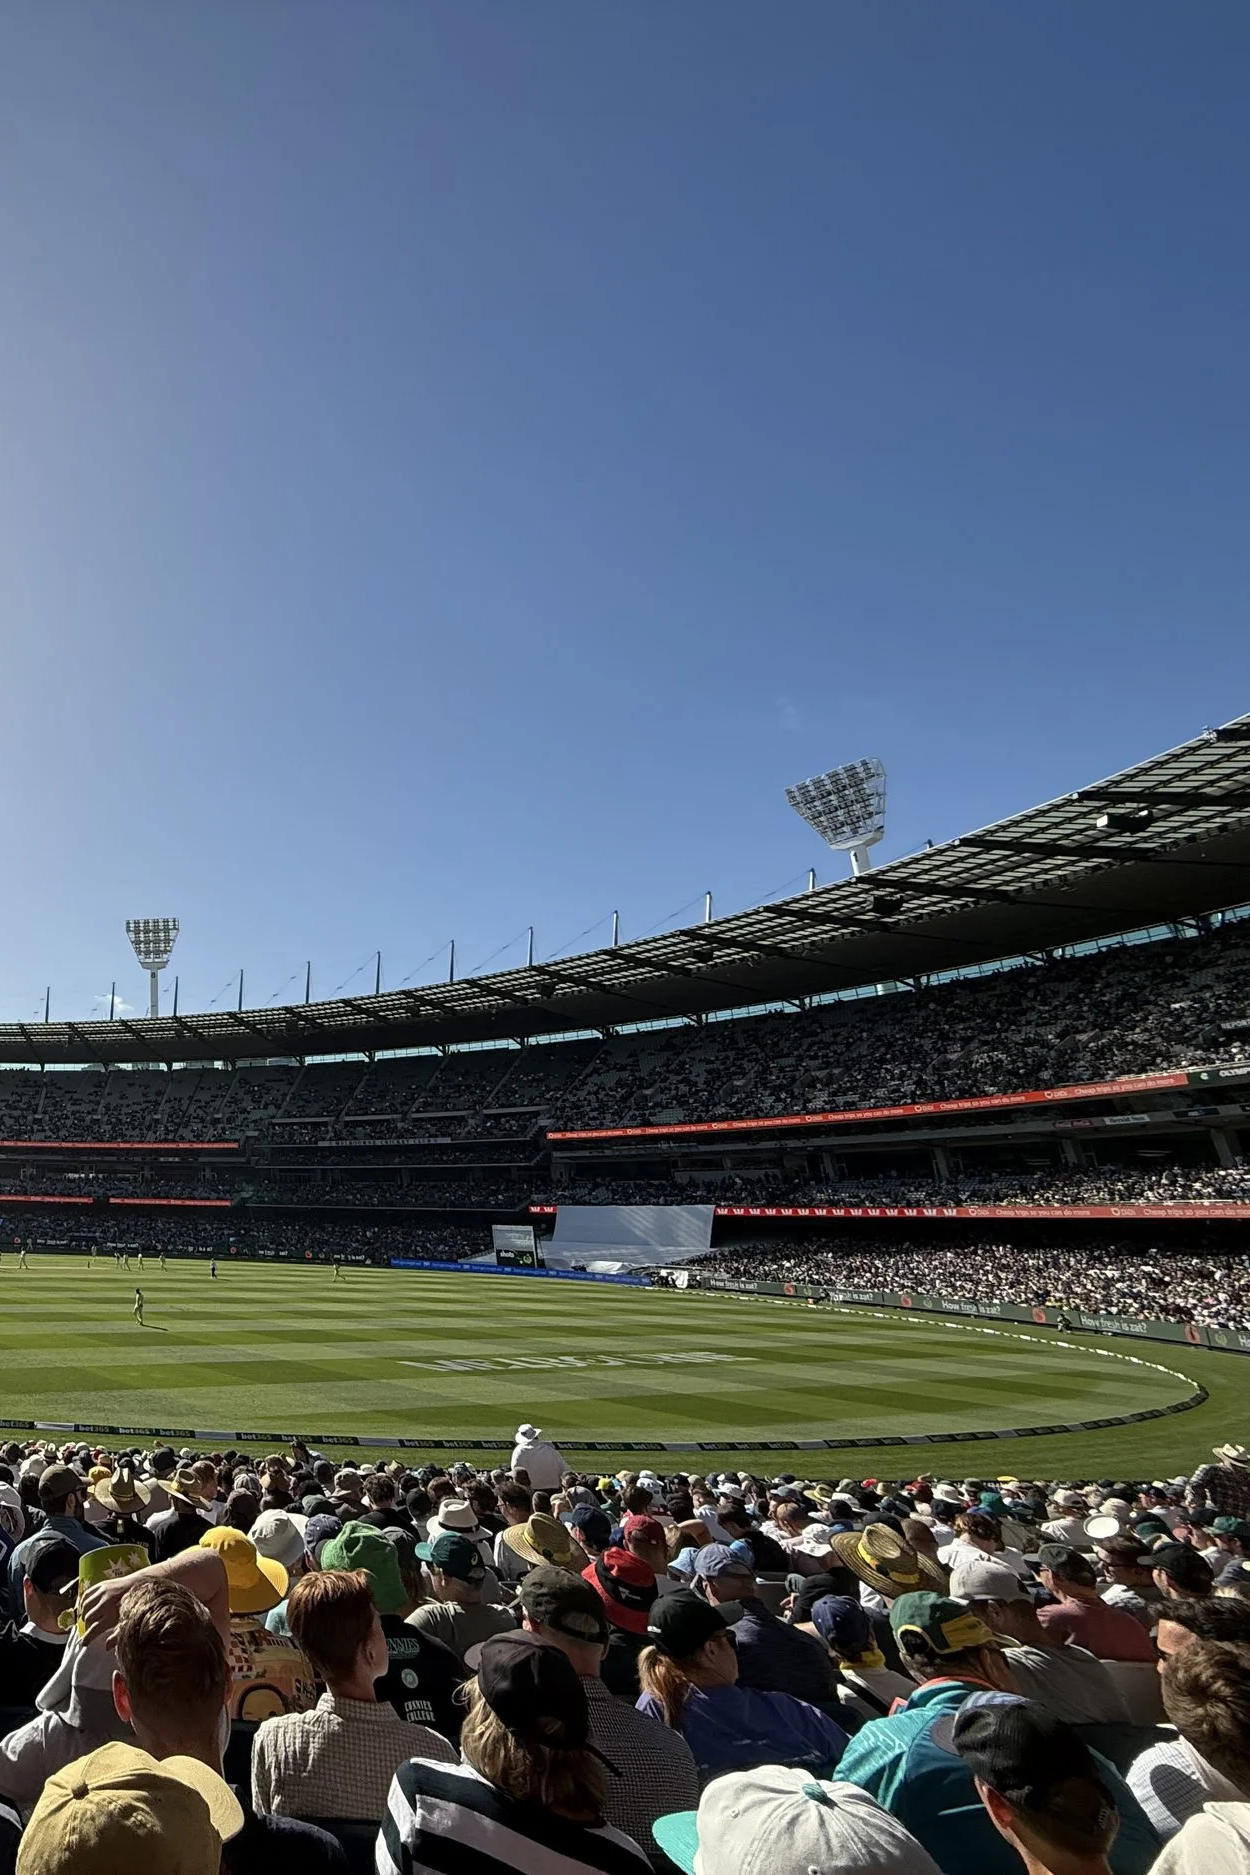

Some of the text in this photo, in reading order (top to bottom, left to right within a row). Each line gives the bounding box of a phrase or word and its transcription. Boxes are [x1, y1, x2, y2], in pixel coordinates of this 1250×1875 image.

[1144, 1209, 1166, 1217] Cheap
[1167, 1209, 1184, 1217] trips
[725, 1280, 739, 1289] fresh
[942, 1300, 1000, 1314] How fresh is zat?
[1100, 1318, 1120, 1330] fresh
[1120, 1320, 1129, 1330] is
[1130, 1323, 1146, 1332] zat?
[406, 1710, 436, 1722] COLLEGE
